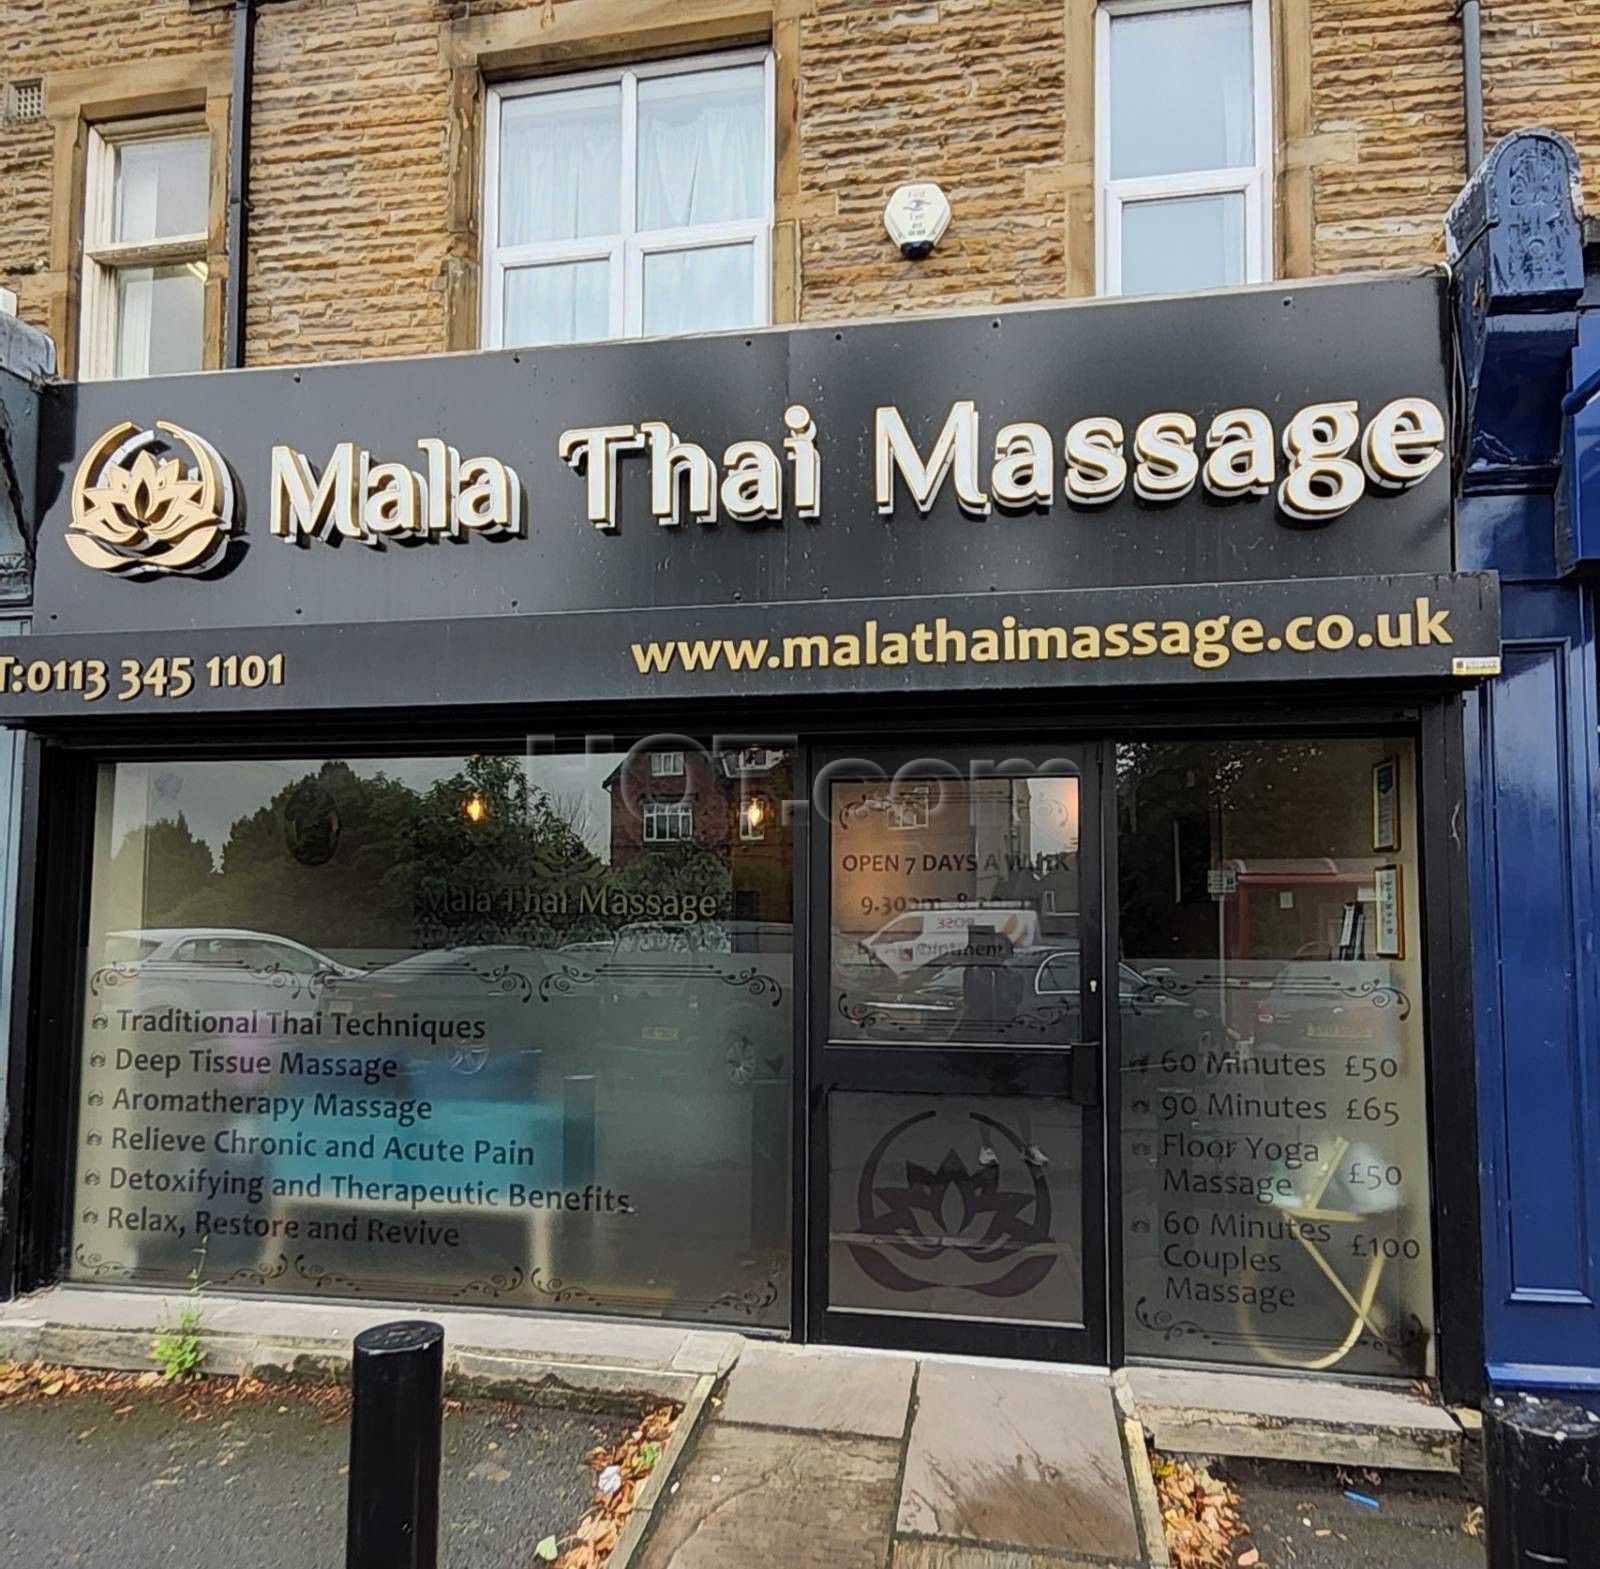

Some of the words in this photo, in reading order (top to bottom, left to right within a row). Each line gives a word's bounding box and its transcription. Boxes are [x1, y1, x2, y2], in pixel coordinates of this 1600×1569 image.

[270, 438, 521, 543] Mala
[559, 405, 820, 528] Thai
[875, 397, 1445, 520] Massage
[631, 597, 1454, 674] www.malathaimassage.co.uk
[0, 656, 109, 700] T:0113
[118, 657, 194, 700] 345
[206, 653, 286, 687] 1101
[842, 854, 900, 873] OPEN
[904, 857, 916, 876] 7
[922, 854, 978, 873] DAYS
[984, 853, 1000, 872] A
[422, 885, 492, 913] Mala
[498, 885, 568, 915] Thai
[579, 886, 717, 924] Massage
[117, 1008, 258, 1033] Traditional
[266, 1010, 322, 1035] Thai
[332, 1012, 486, 1045] Techniques
[116, 1048, 181, 1078] Deep
[189, 1049, 271, 1074] Tissue
[279, 1052, 398, 1084] Massage
[1161, 1050, 1197, 1073] 60
[1206, 1050, 1326, 1077] Minutes
[1345, 1055, 1398, 1083] £50
[112, 1087, 304, 1122] Aromatherapy
[314, 1093, 432, 1127] Massage
[1161, 1095, 1197, 1121] 90
[1207, 1093, 1327, 1120] Minutes
[1346, 1097, 1400, 1126] £65
[111, 1126, 206, 1151] Relieve
[214, 1129, 317, 1156] Chronic
[325, 1134, 375, 1158] and
[384, 1136, 465, 1162] Acute
[474, 1140, 535, 1165] Pain
[1163, 1133, 1237, 1158] Floor
[1246, 1136, 1319, 1170] Yoga
[110, 1167, 264, 1203] Detoxifying
[272, 1173, 321, 1197] and
[331, 1174, 499, 1210] Therapeutic
[509, 1183, 630, 1214] Benefits
[1163, 1168, 1293, 1204] Massage
[1349, 1163, 1403, 1190] £50
[107, 1206, 186, 1238] Relax,
[196, 1211, 299, 1238] Restore
[307, 1216, 357, 1241] and
[367, 1218, 460, 1247] Revive
[1163, 1210, 1199, 1235] 60
[1211, 1213, 1331, 1243] Minutes
[1163, 1243, 1281, 1277] Couples
[1351, 1234, 1420, 1259] £100
[1165, 1276, 1295, 1314] Massage
